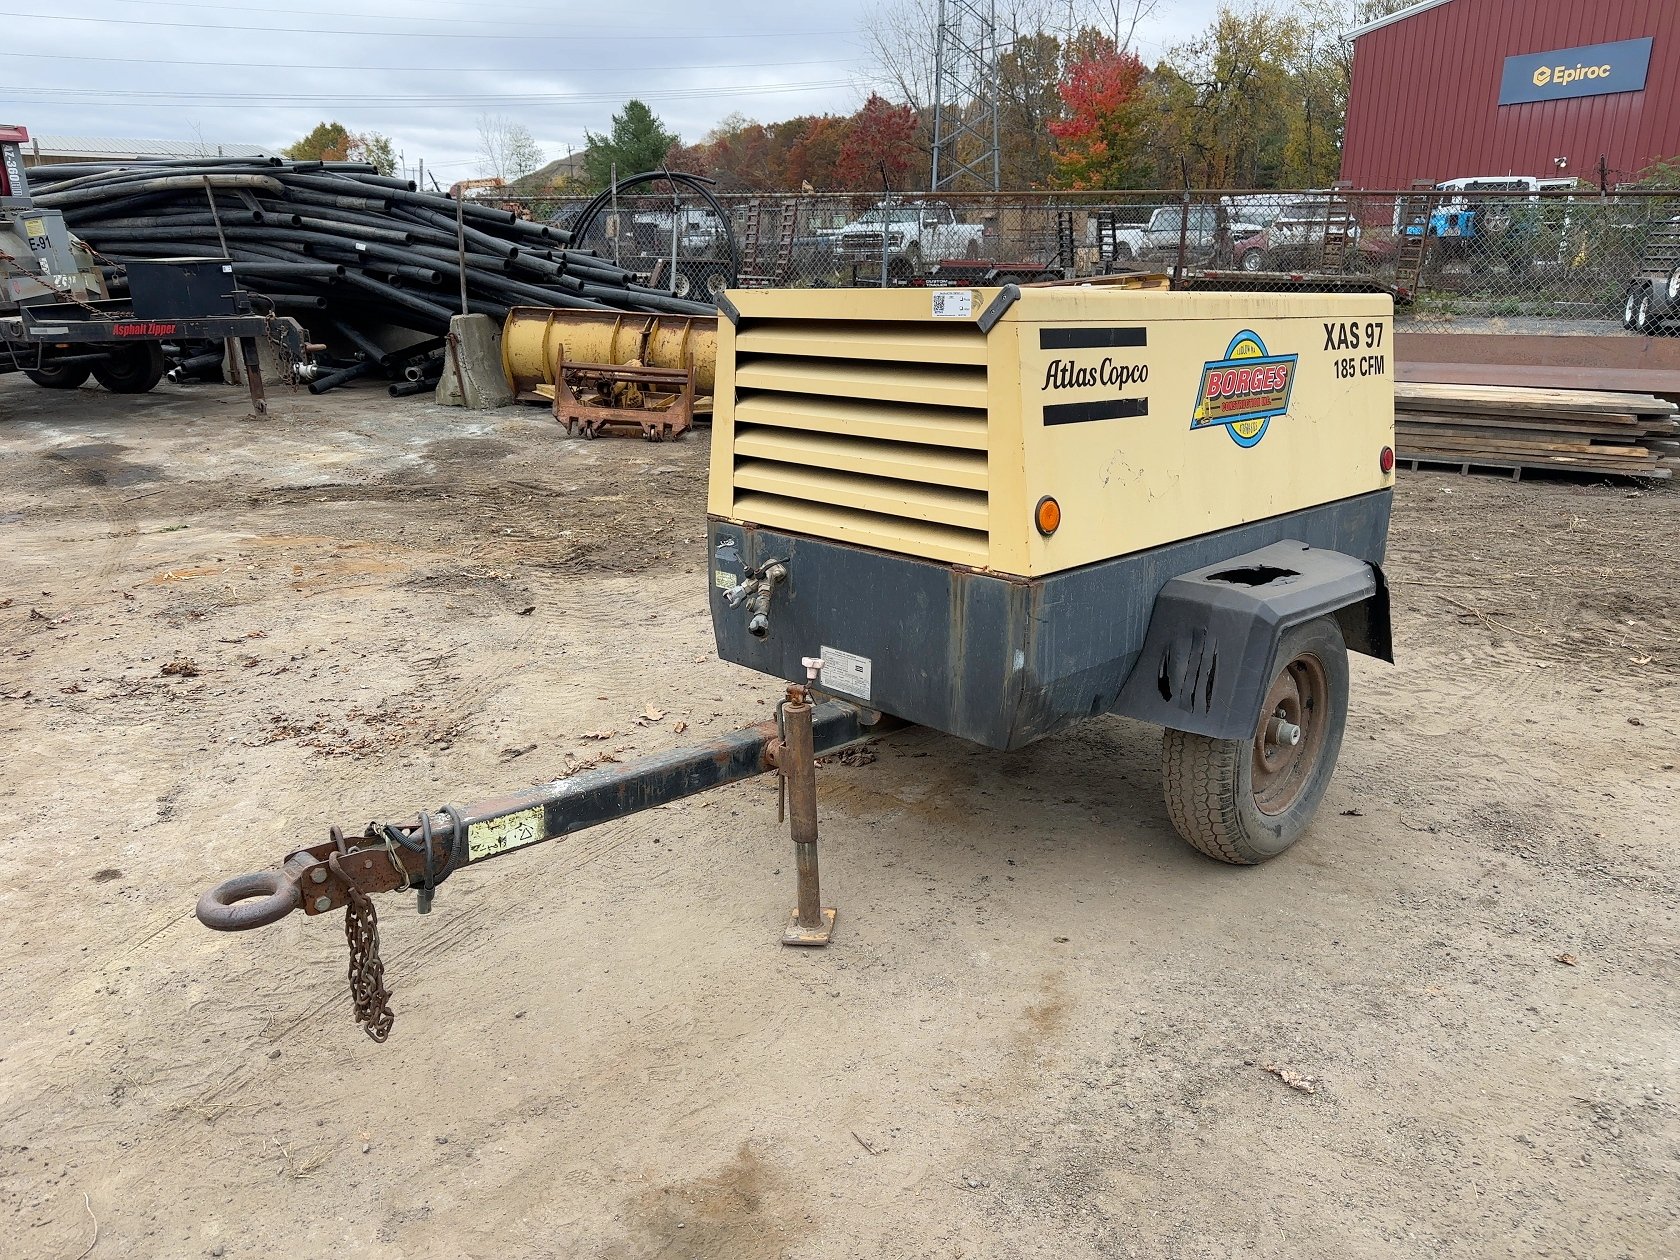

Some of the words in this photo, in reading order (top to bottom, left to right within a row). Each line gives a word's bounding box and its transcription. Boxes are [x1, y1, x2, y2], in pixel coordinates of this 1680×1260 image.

[1552, 63, 1612, 86] Epiroc
[28, 235, 52, 251] E-91
[112, 323, 147, 337] Asphalt
[147, 322, 177, 335] Zipper
[1323, 321, 1360, 351] XAS
[1365, 322, 1384, 348] 97
[1041, 359, 1098, 391] Atlas
[1100, 357, 1149, 391] Copco
[1334, 358, 1356, 379] 185
[1360, 355, 1385, 377] CFM
[1206, 364, 1288, 399] BORGES
[1221, 397, 1261, 413] CONSTRUCTION
